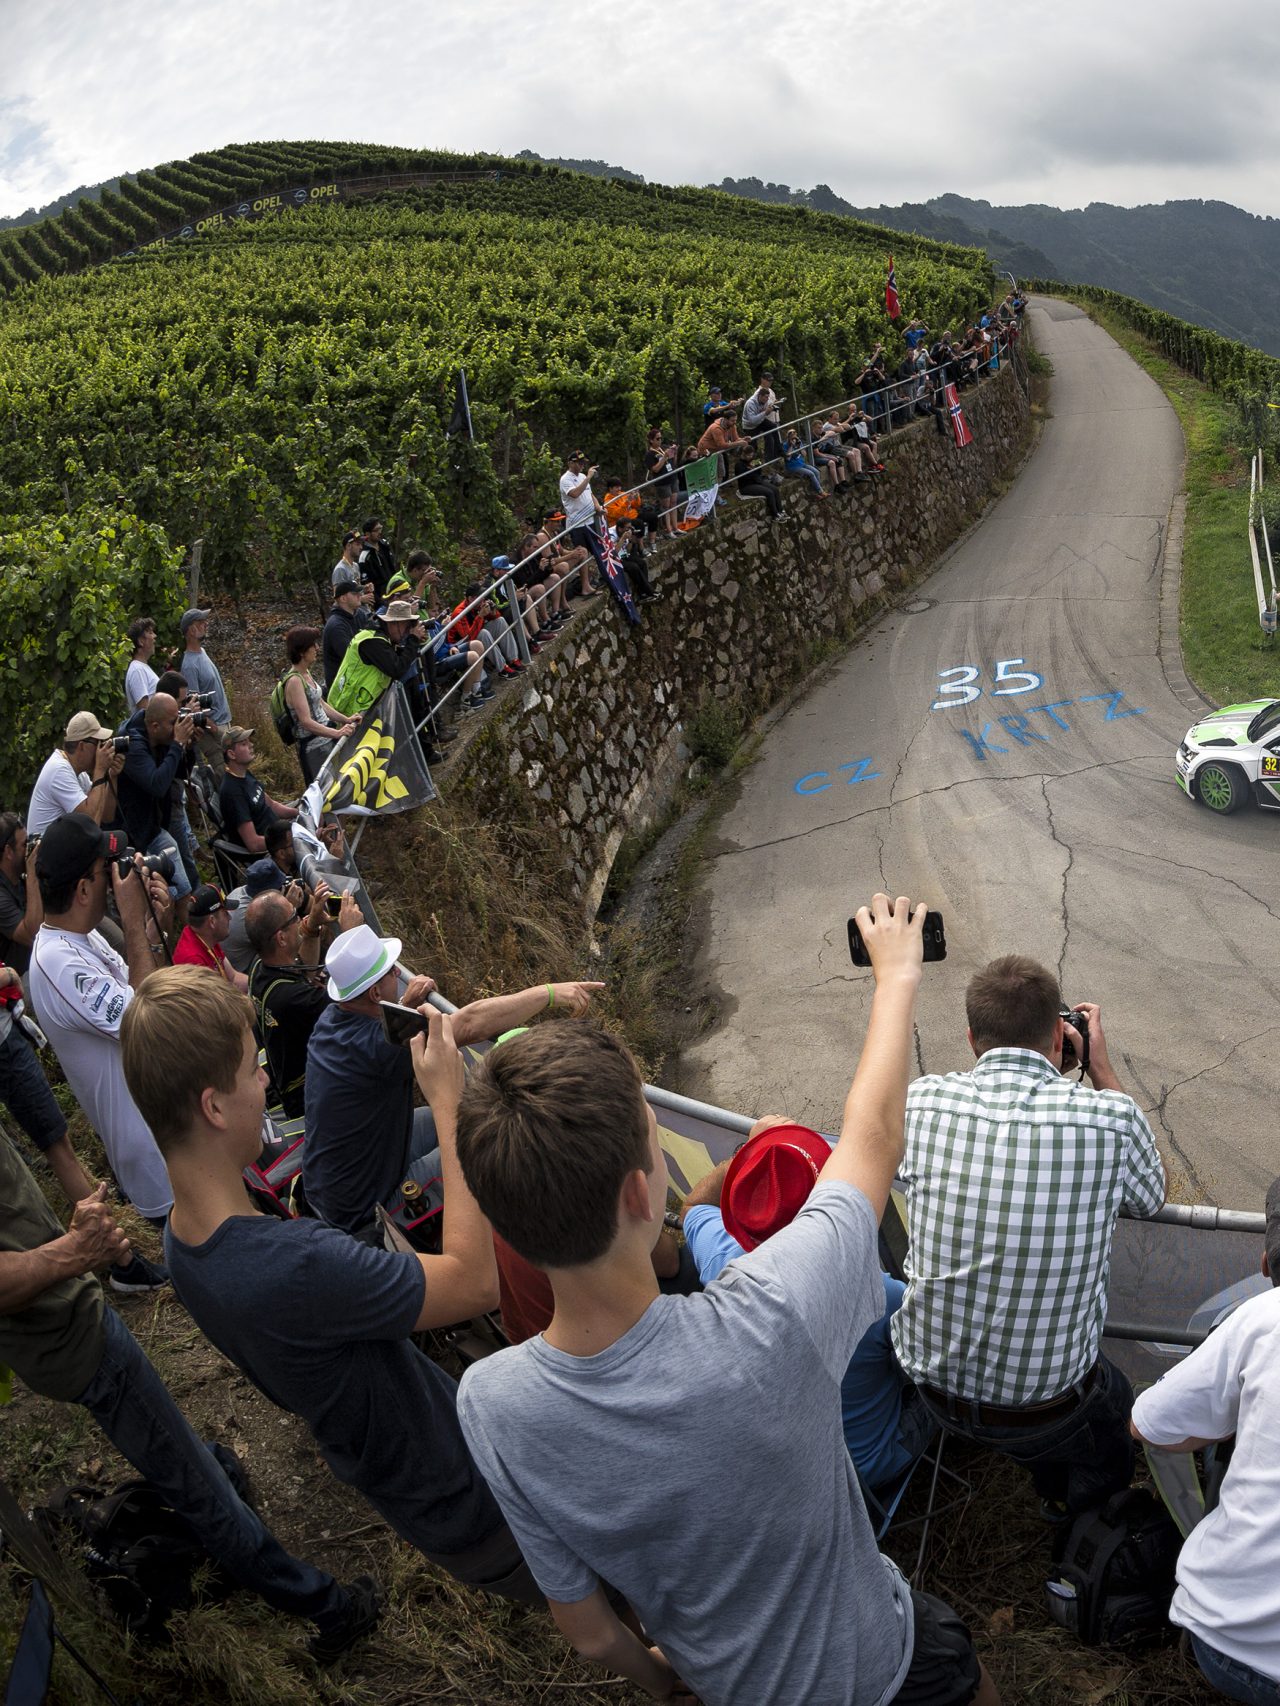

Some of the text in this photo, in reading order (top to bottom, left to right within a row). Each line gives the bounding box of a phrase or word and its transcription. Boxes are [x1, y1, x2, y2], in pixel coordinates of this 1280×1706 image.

[310, 184, 340, 199] OPEL
[253, 195, 283, 212] OPEL
[196, 213, 226, 233] OPEL
[931, 658, 1044, 711] 35
[1265, 757, 1277, 771] 32
[794, 756, 884, 795] CZ
